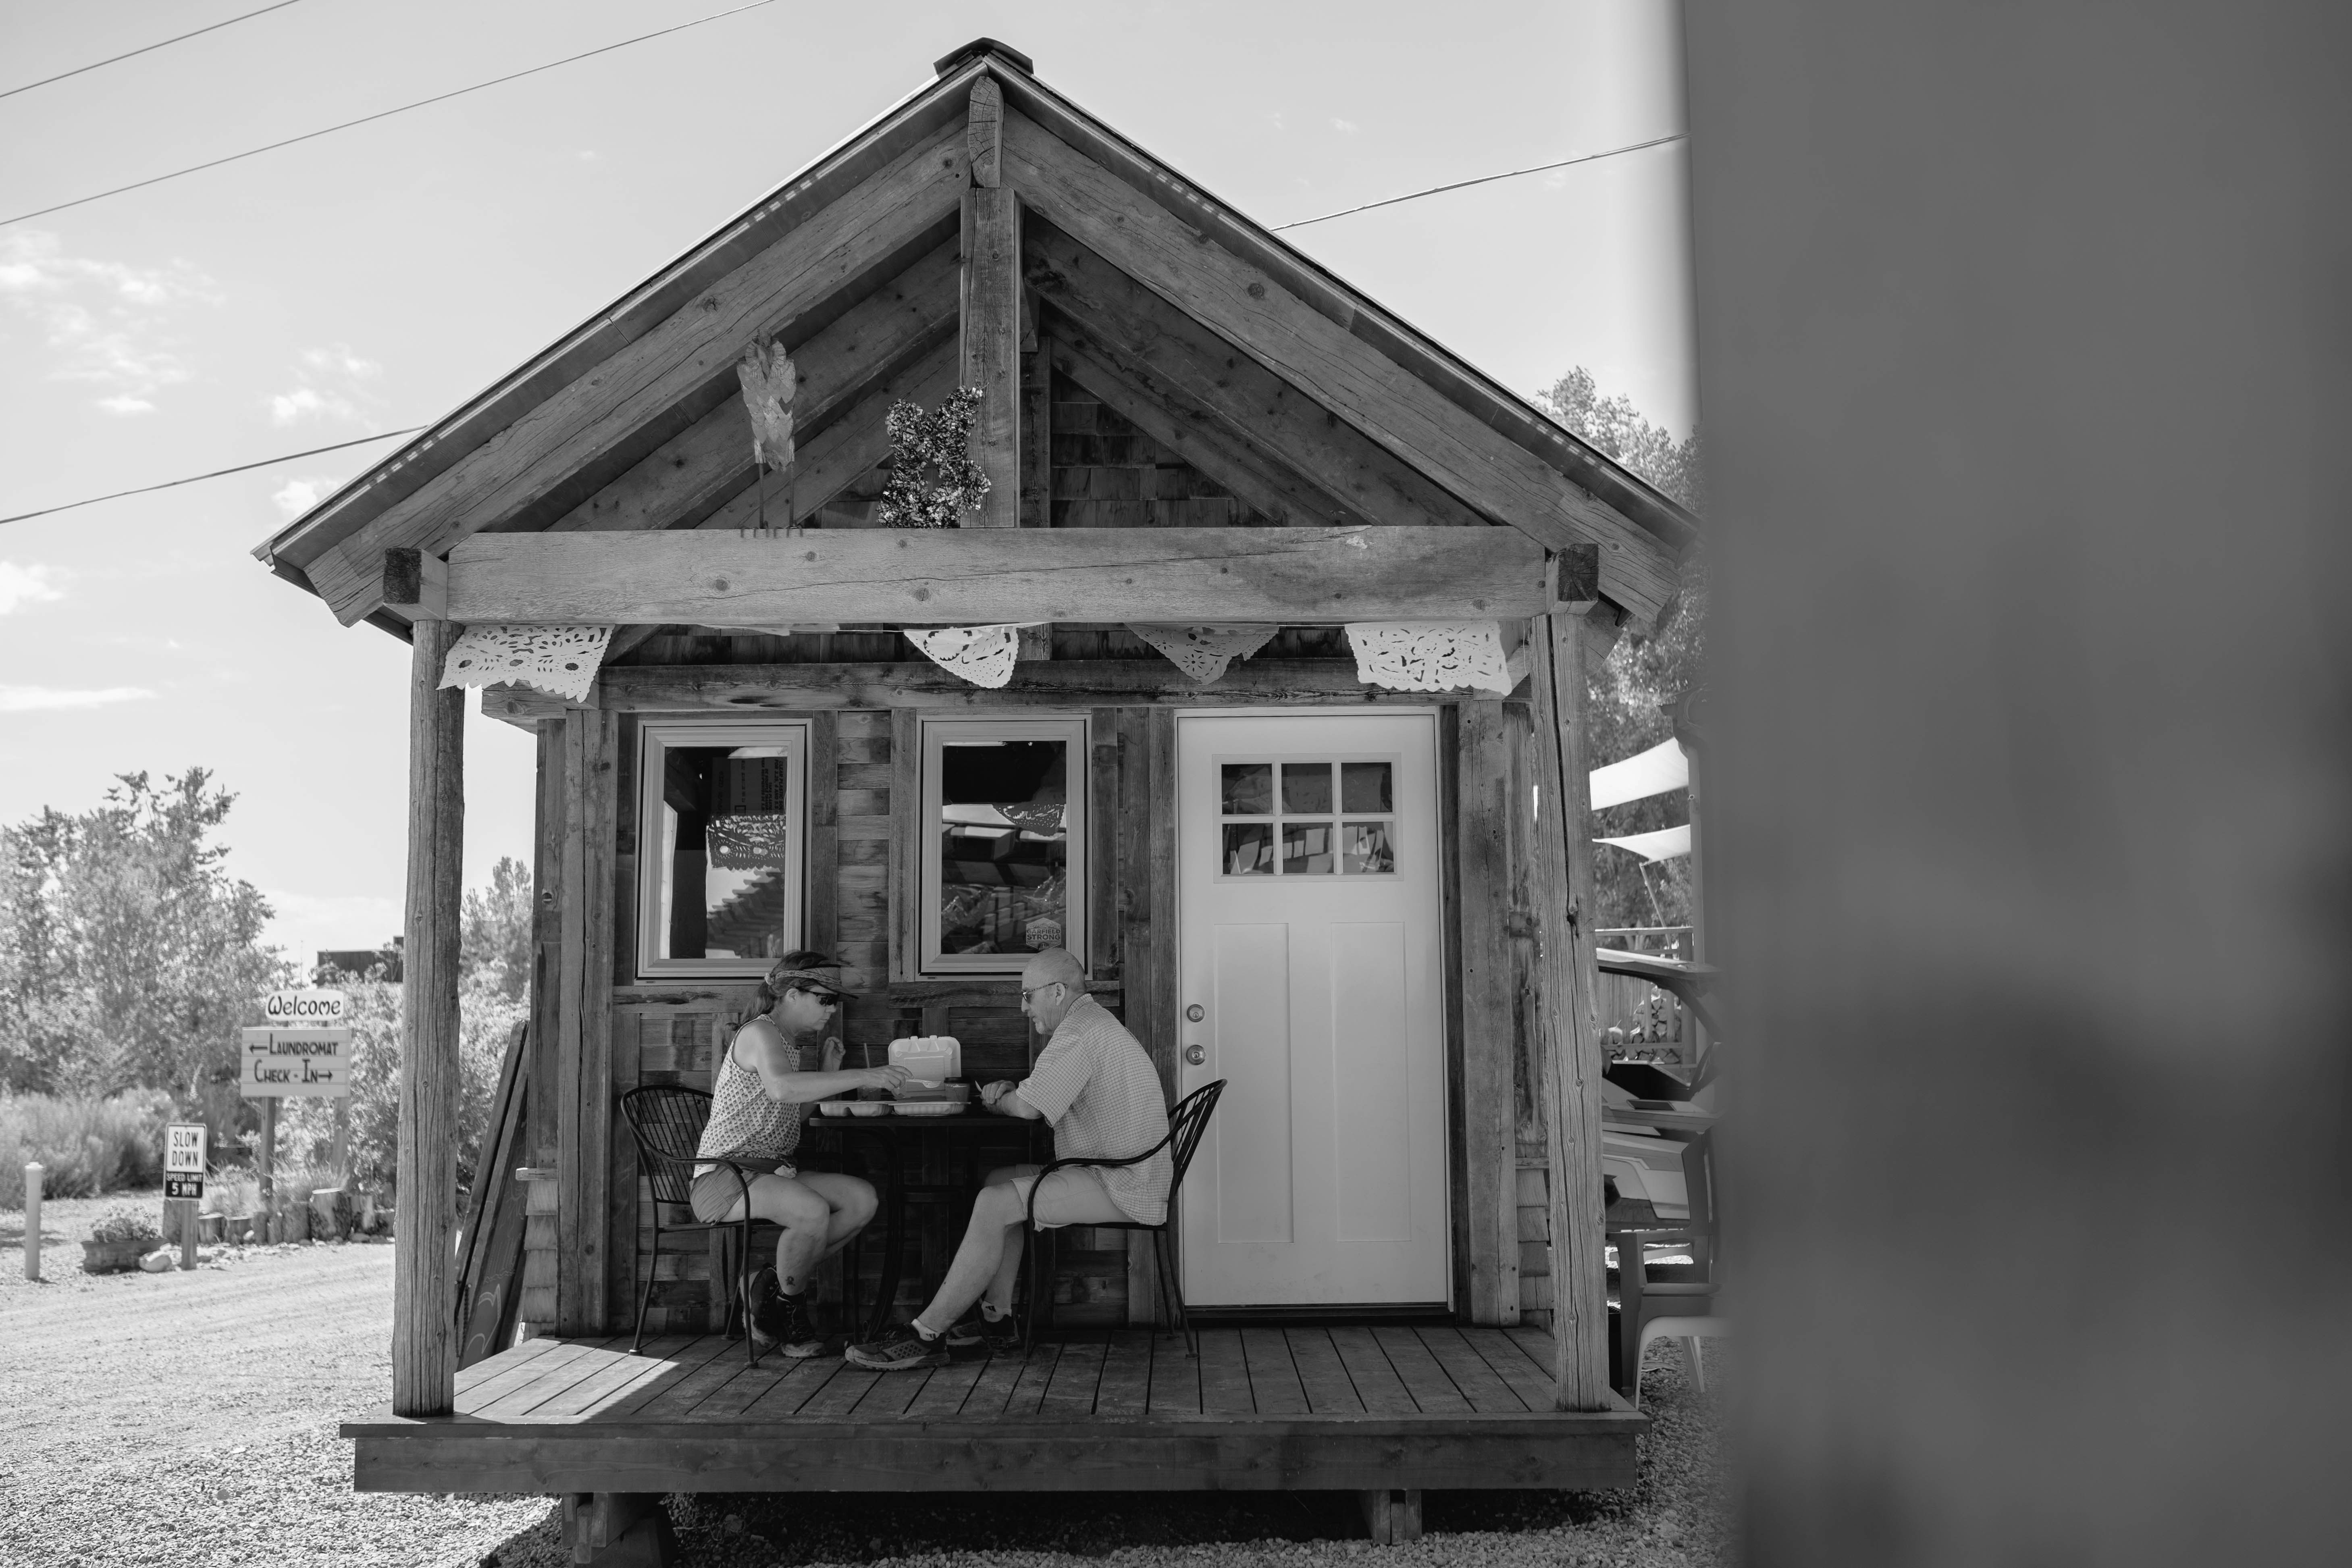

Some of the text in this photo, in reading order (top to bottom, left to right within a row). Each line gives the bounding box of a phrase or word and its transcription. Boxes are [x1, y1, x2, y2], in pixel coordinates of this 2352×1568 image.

[268, 995, 341, 1016] Welcome
[269, 1032, 339, 1056] LAUNDROMAT
[173, 1131, 199, 1147] SLOW
[172, 1150, 199, 1167] DOWN
[166, 1172, 203, 1183] SPEED LIMIT
[171, 1182, 198, 1196] 5 MPH
